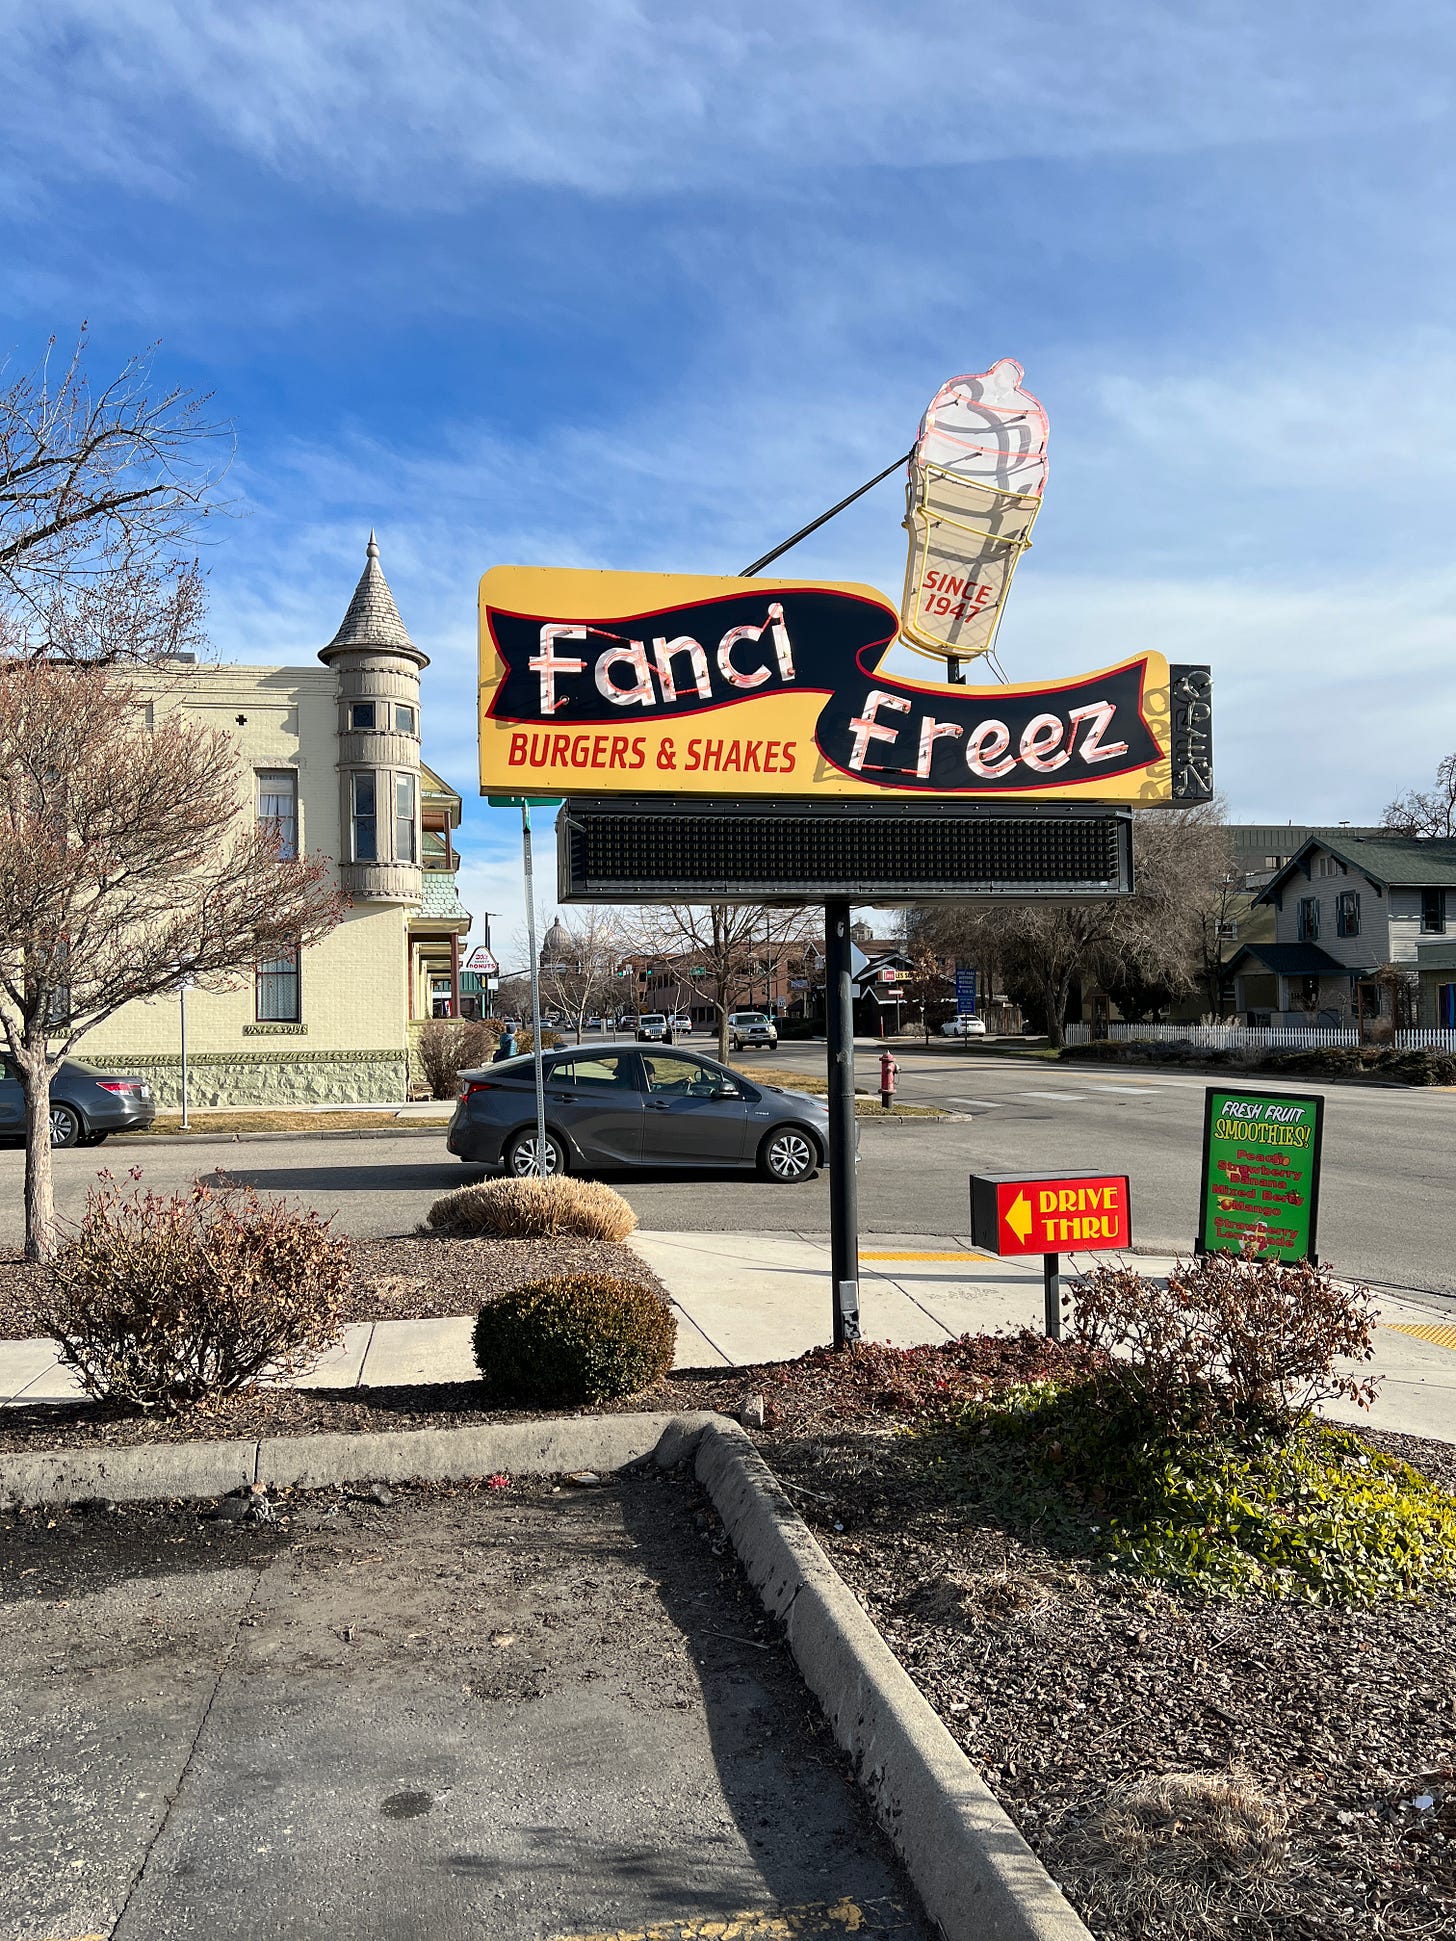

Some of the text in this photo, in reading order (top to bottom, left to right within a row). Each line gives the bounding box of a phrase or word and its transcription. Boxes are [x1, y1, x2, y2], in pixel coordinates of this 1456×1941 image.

[922, 570, 993, 605] SINCE
[925, 593, 982, 624] 1947
[528, 602, 796, 715] Fanci
[848, 690, 1129, 779] Freez
[508, 733, 797, 774] BURGERS & SHAKES
[1221, 1101, 1306, 1123] FRESH FRUIT
[1214, 1119, 1311, 1149] SMOOTHIES!
[1217, 1160, 1302, 1181] Strawberry
[1230, 1173, 1287, 1190] Banana
[1039, 1187, 1119, 1213] DRIVE
[1212, 1184, 1256, 1199] Mixed
[1231, 1201, 1281, 1217] Mango
[1041, 1215, 1119, 1241] THRU
[1214, 1217, 1299, 1239] Strawberry
[1217, 1228, 1295, 1248] Lemonade
